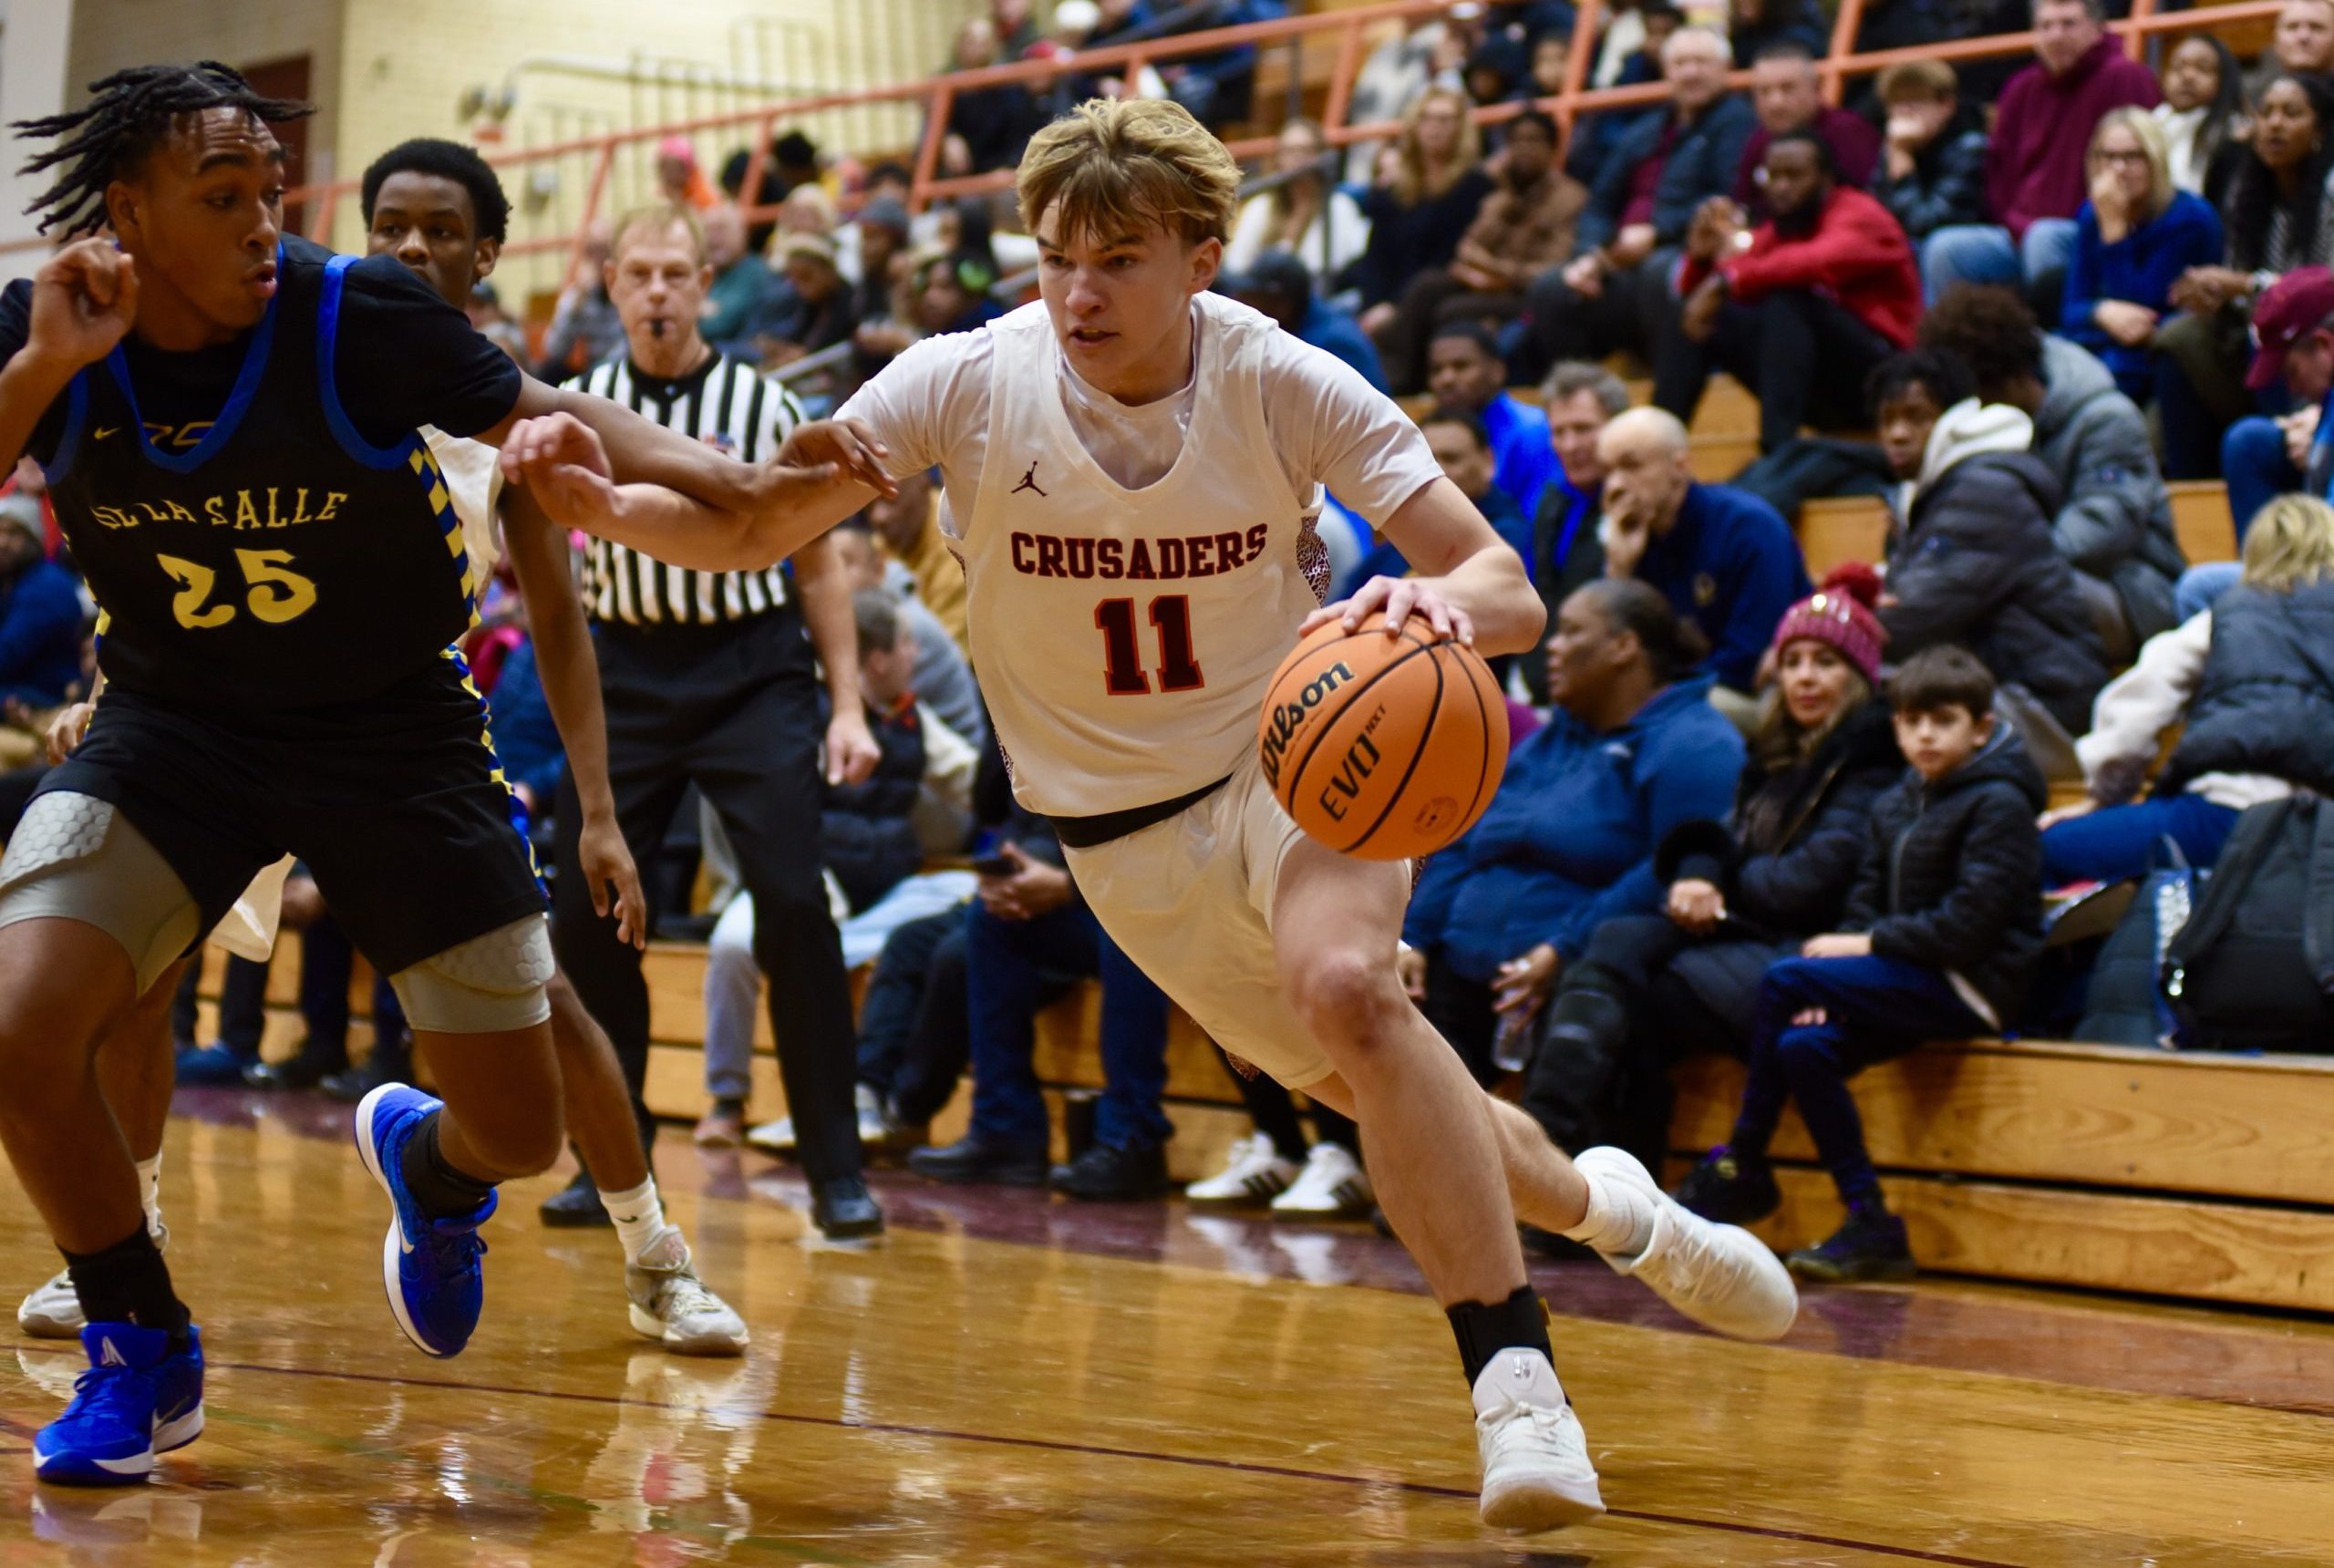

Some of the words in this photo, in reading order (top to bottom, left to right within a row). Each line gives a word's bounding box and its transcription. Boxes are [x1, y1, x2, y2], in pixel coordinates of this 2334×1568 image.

[134, 499, 197, 523] LA
[204, 487, 348, 530] SALLE
[1011, 522, 1267, 580] CRUSADERS
[156, 548, 317, 629] 25
[1094, 594, 1205, 696] 11
